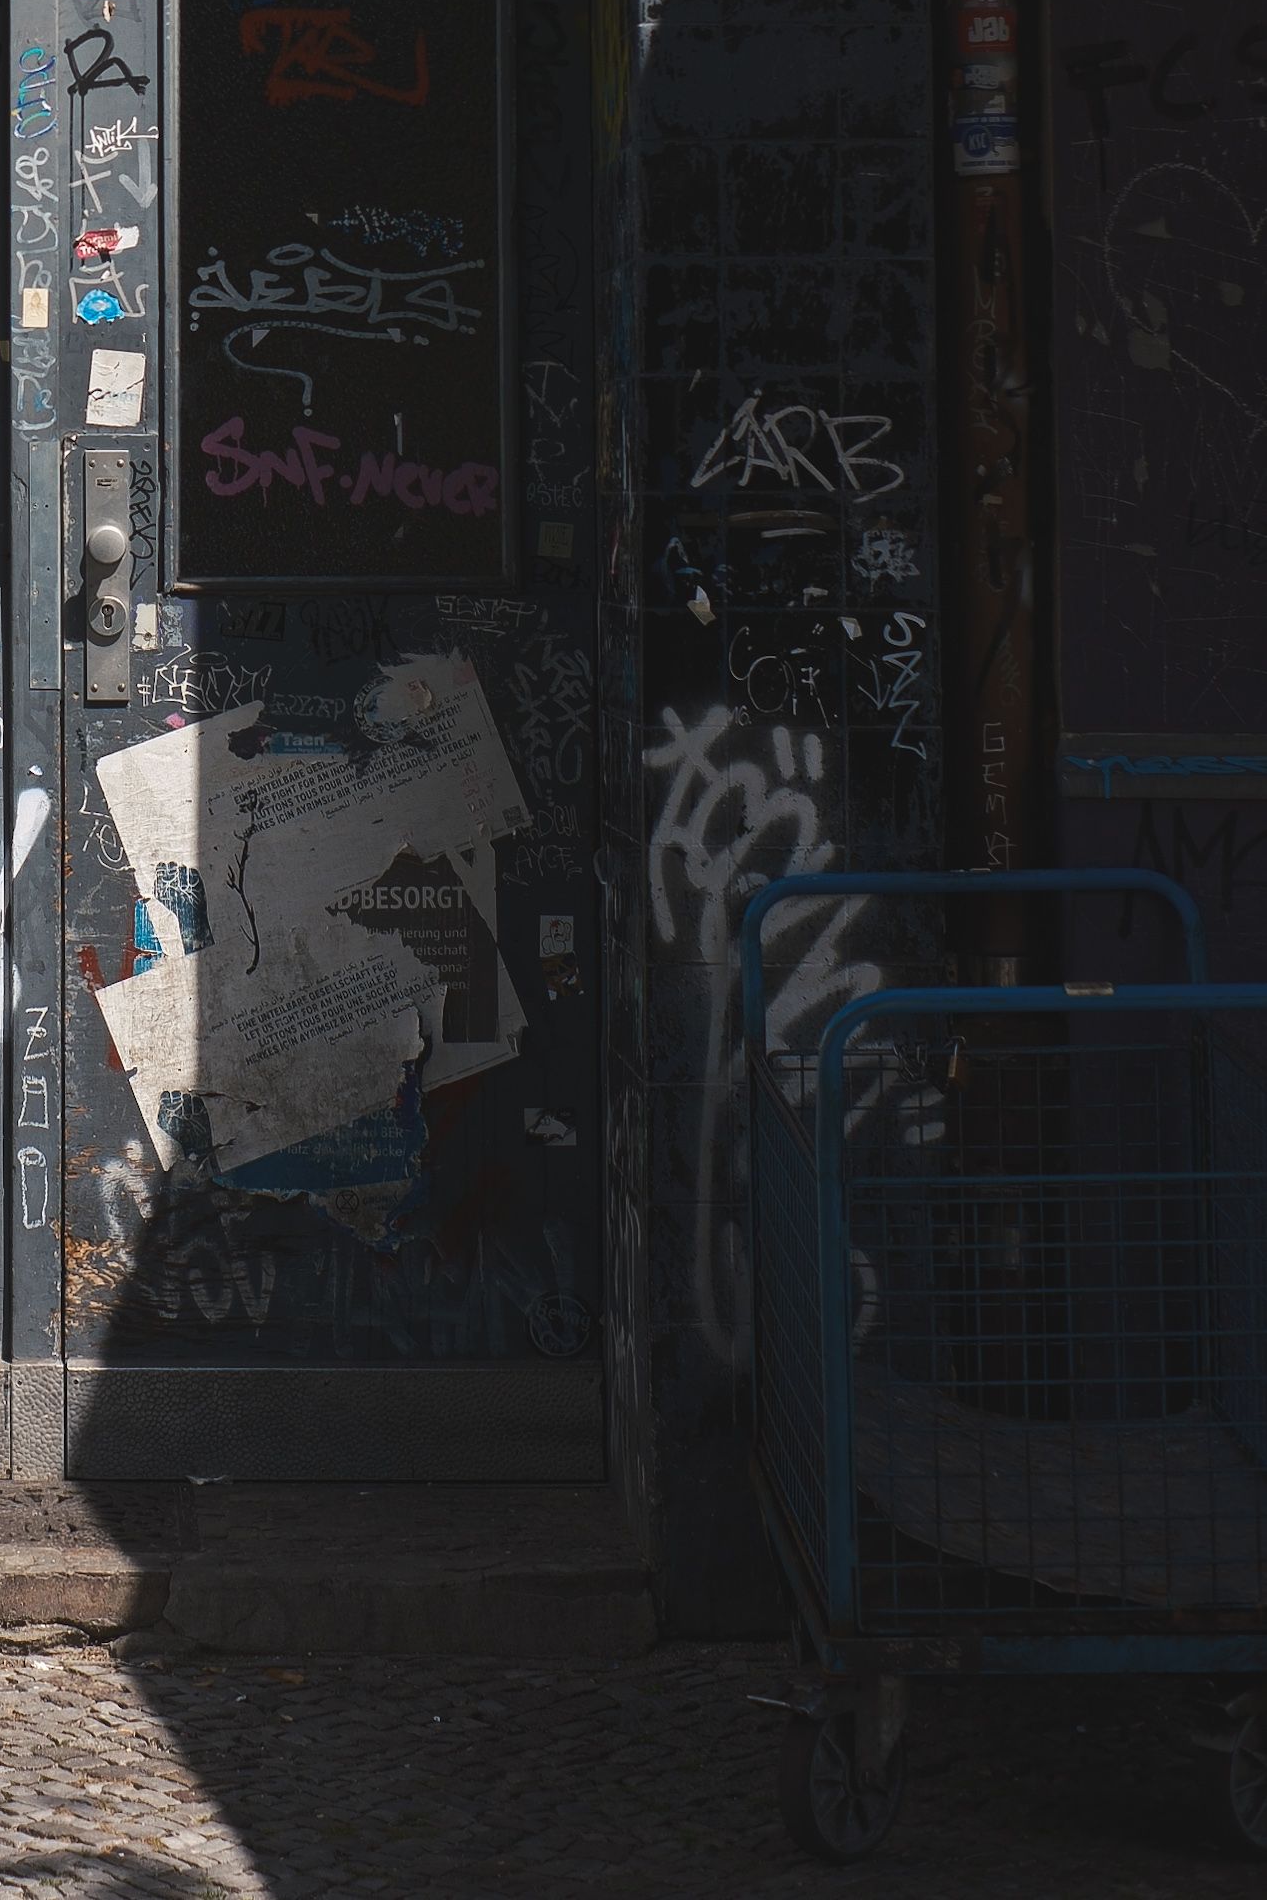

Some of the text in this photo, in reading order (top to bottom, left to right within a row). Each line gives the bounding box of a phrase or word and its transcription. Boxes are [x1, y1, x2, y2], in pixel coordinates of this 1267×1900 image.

[293, 789, 319, 808] TOUS
[316, 779, 343, 800] POUR
[298, 776, 318, 794] FOR
[351, 769, 388, 795] TOPLUM
[360, 885, 466, 910] BESORGT
[236, 1014, 259, 1033] EINE
[257, 996, 308, 1026] UNTEILBARE
[244, 1026, 262, 1042] LET
[260, 1020, 275, 1037] US
[300, 1001, 320, 1020] FOR
[318, 994, 334, 1013] AN
[297, 1013, 322, 1033] TOUS
[320, 1003, 347, 1024] POUR
[345, 994, 367, 1014] UNE
[354, 997, 391, 1022] TOPLUM
